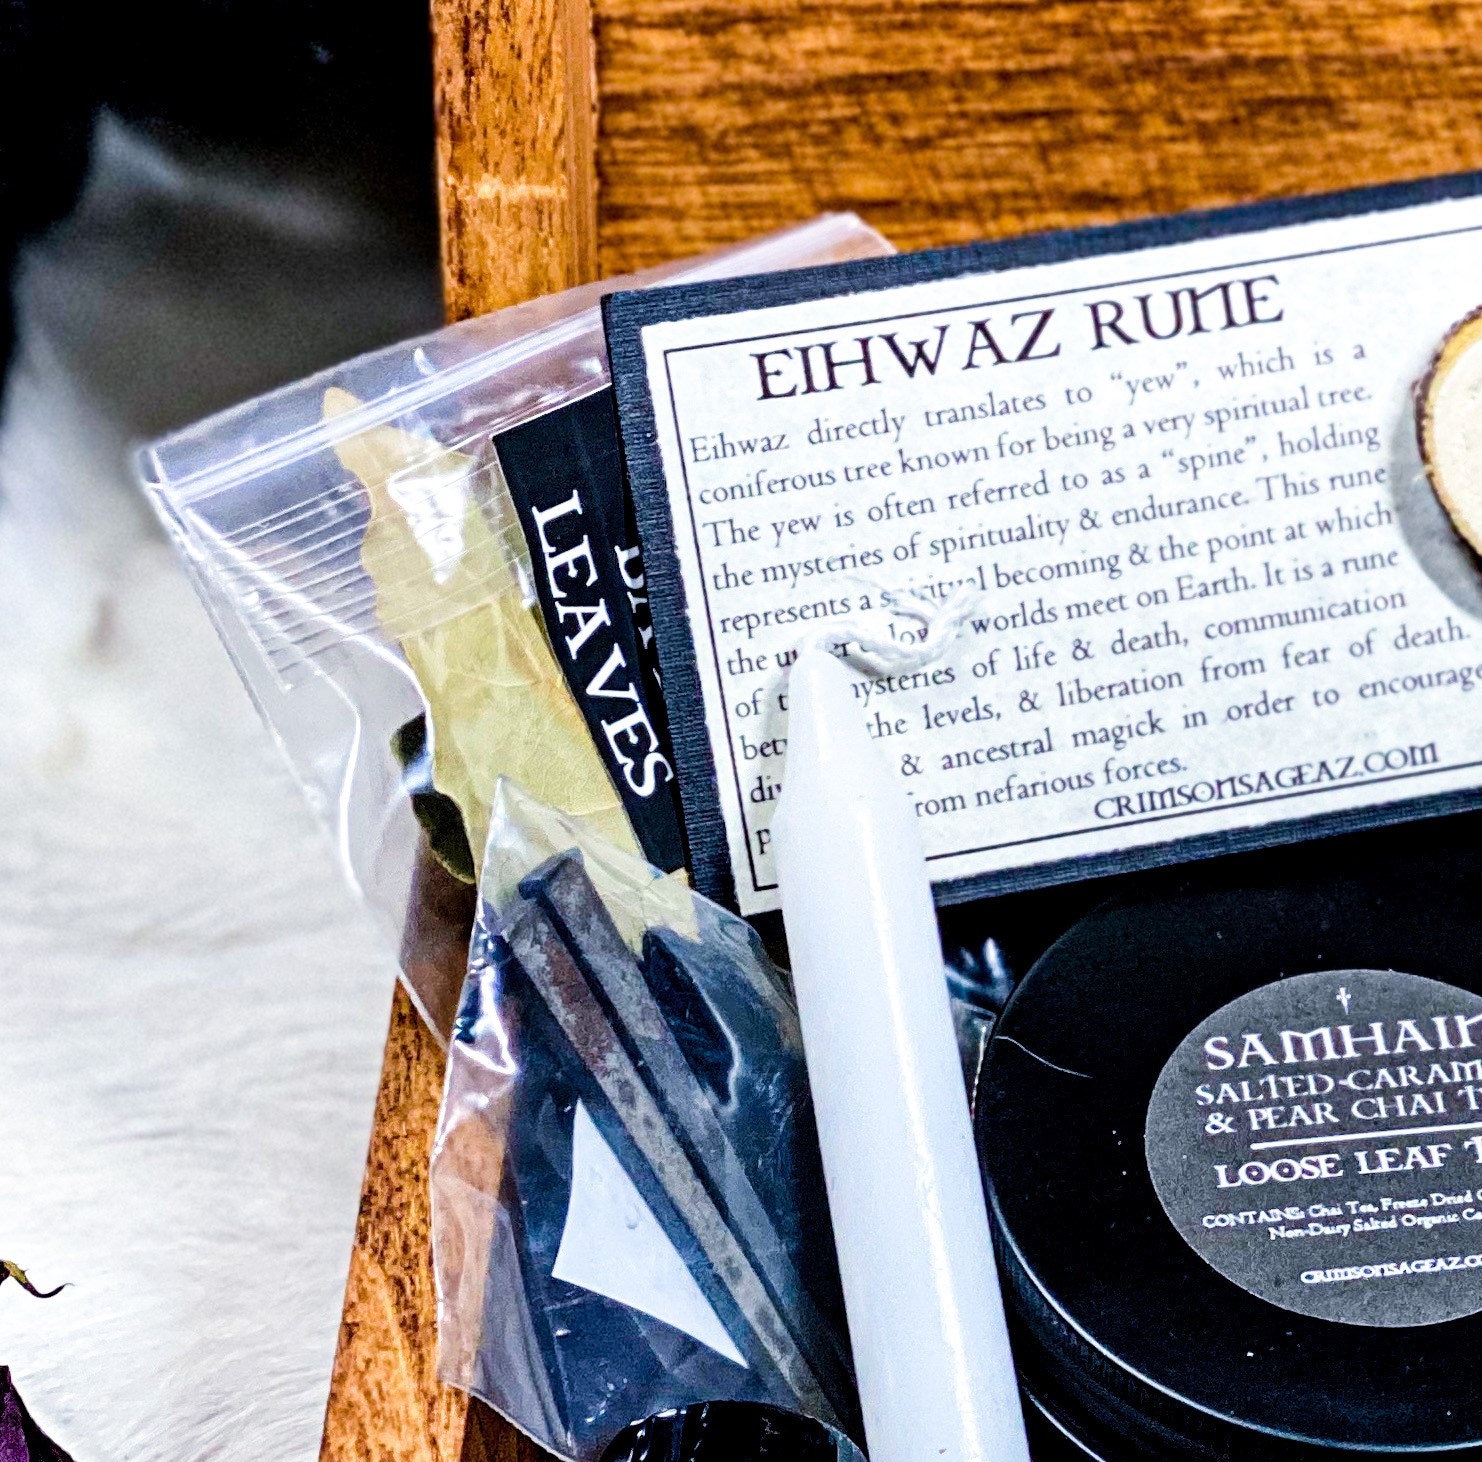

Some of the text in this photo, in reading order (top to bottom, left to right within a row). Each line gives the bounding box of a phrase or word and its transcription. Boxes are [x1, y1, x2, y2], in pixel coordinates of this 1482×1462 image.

[748, 274, 1284, 402] EIHWAZ RUNE
[689, 431, 790, 464] Eihwaz
[807, 407, 906, 446] directly
[924, 390, 1047, 427] translates
[1217, 345, 1295, 380] which
[698, 384, 1372, 505] coniferous tree known for being very spiritual tree.
[701, 518, 761, 548] The
[770, 514, 822, 548] yew
[867, 491, 936, 523] often
[947, 469, 1051, 510] referred
[1277, 422, 1381, 457] holding
[712, 561, 755, 592] the
[760, 548, 884, 589] mysteries
[929, 514, 1070, 564] spirituality
[1111, 491, 1250, 526] endurance.
[1255, 472, 1320, 502] This
[1328, 468, 1386, 491] rune
[719, 597, 851, 640] represents
[992, 550, 1123, 589] becoming
[1158, 534, 1199, 562] the
[1206, 527, 1276, 564] point
[1315, 501, 1401, 536] which
[726, 551, 1398, 676] the worlds meet Earth. rune
[531, 489, 674, 798] LEAVES
[921, 616, 1470, 730] levels, liberation from fear death.
[1012, 592, 1407, 672] life death, communication
[941, 726, 1055, 771] ancestral
[1071, 708, 1166, 752] magick
[1224, 689, 1296, 722] order
[975, 756, 1188, 807] nefarious forces.
[1093, 741, 1440, 820] CRIMSONSAGEAZ.COM
[1204, 1111, 1238, 1136] &
[1246, 1102, 1341, 1131] PEAR
[1350, 1091, 1447, 1120] CHAI
[1213, 1153, 1344, 1189] LOOSE
[1353, 1142, 1453, 1175] LEAF
